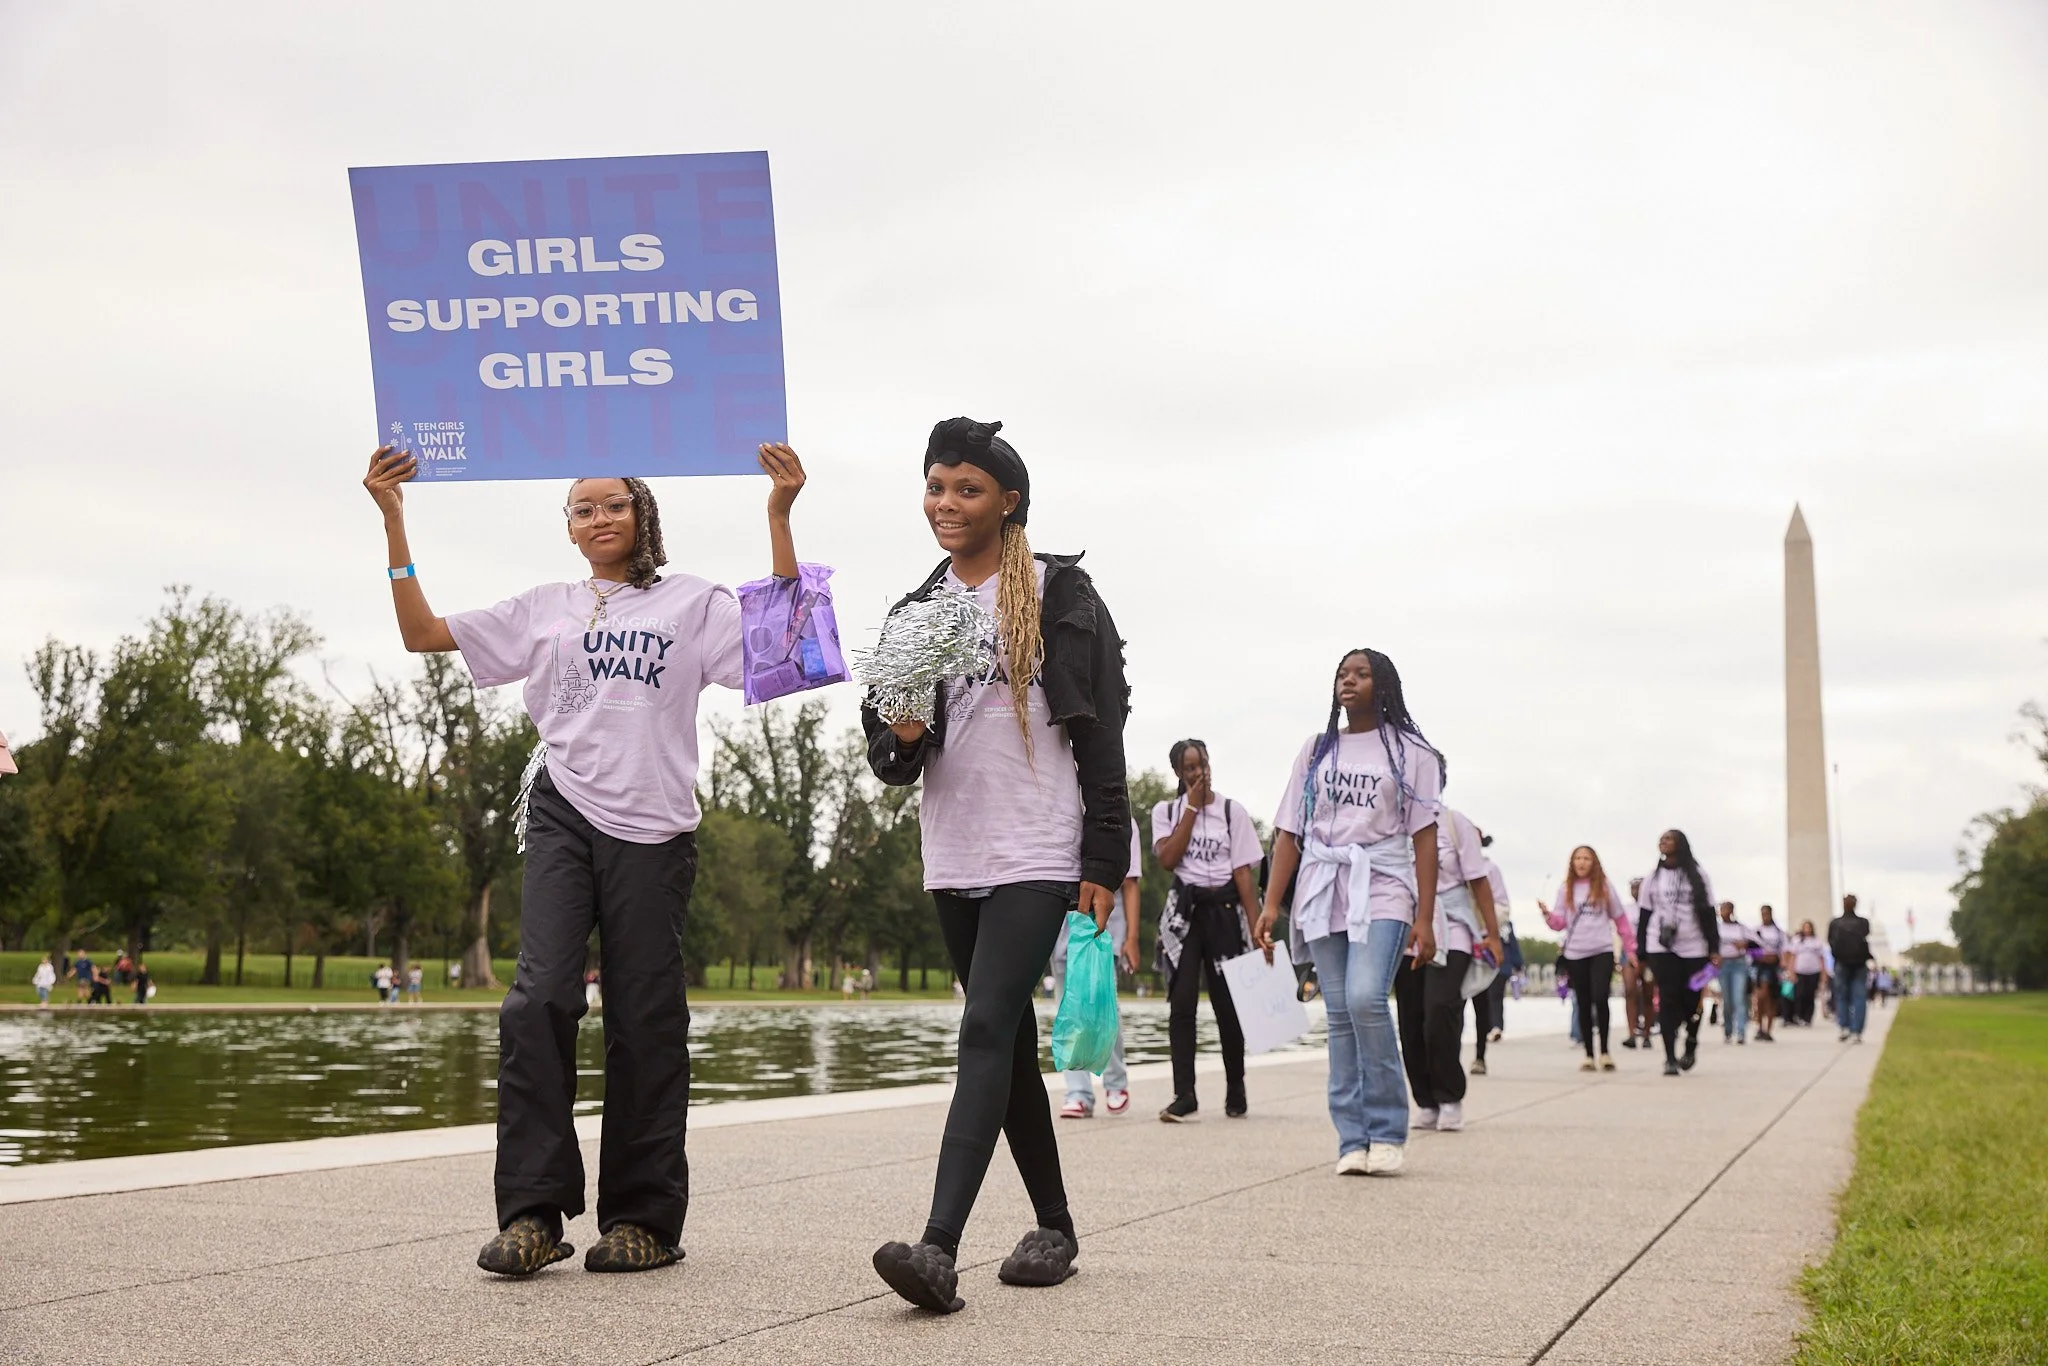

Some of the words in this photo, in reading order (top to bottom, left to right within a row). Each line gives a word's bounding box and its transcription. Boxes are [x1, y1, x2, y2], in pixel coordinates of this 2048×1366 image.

[467, 233, 665, 277] GIRLS
[387, 288, 758, 333] SUPPORTING
[478, 348, 674, 390] GIRLS
[413, 422, 437, 431] TEEN
[438, 421, 465, 430] GIRLS
[417, 431, 465, 446] UNITY
[422, 446, 467, 460] WALK
[628, 618, 679, 635] GIRLS
[583, 630, 674, 661] UNITY
[587, 656, 666, 689] WALK
[1325, 770, 1382, 790] UNITY
[1327, 787, 1378, 809] WALK
[1191, 836, 1223, 850] NITY
